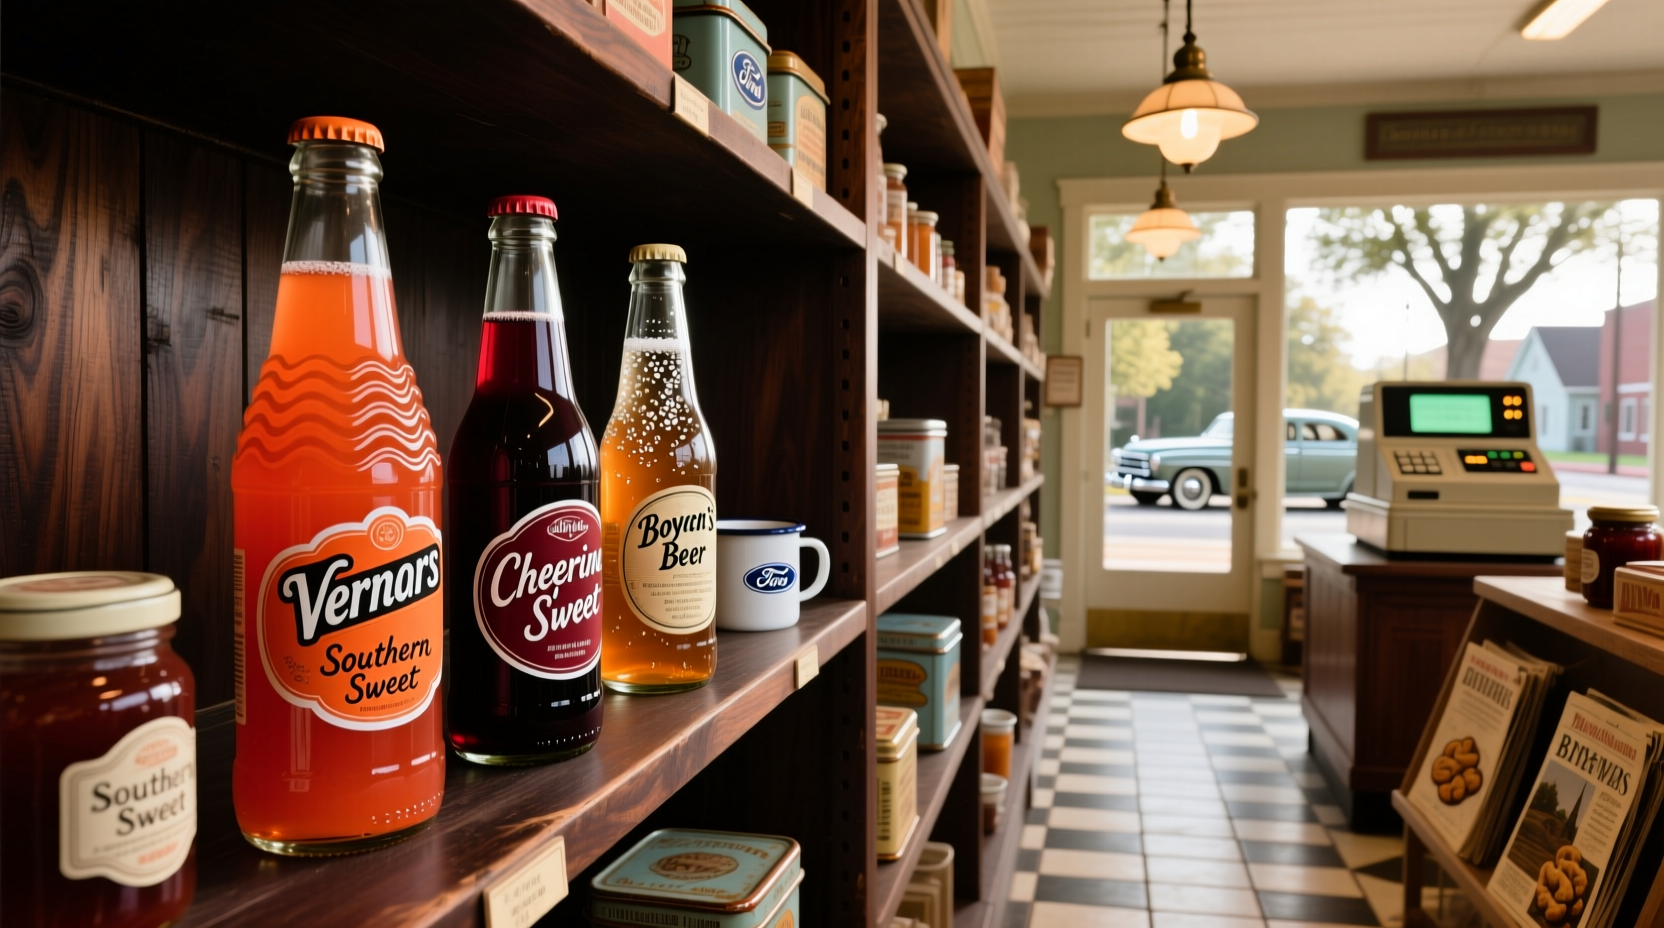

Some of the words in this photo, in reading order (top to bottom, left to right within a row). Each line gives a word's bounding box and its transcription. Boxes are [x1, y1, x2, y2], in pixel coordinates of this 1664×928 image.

[658, 541, 707, 571] Beer
[282, 549, 440, 641] Vernars
[523, 583, 602, 642] Sweet
[319, 635, 432, 677] Southern
[344, 665, 421, 705] Sweet
[116, 790, 186, 837] Sweet
